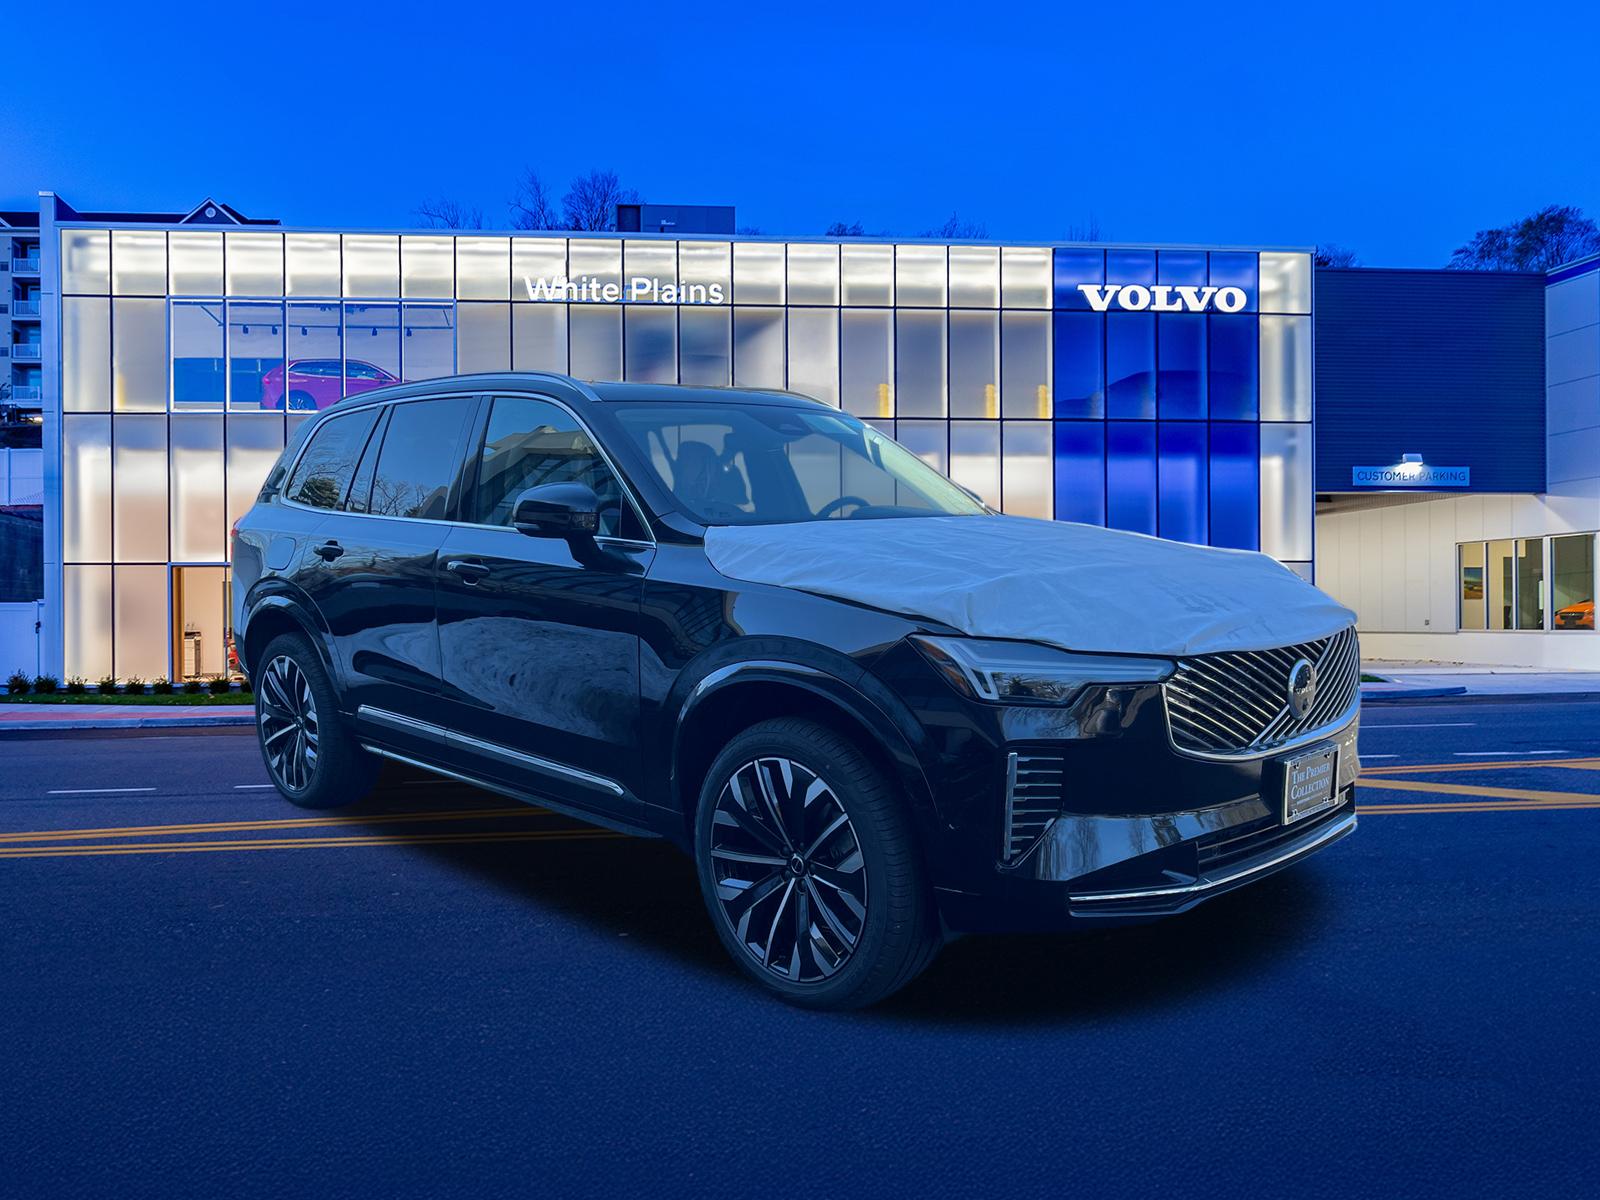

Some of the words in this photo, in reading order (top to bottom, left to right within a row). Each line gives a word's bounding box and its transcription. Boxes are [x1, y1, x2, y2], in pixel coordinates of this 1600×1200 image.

[524, 275, 620, 302] White
[631, 277, 725, 304] Plains
[1077, 284, 1247, 313] VOLVO
[1357, 471, 1416, 481] CUSTOMER
[1419, 471, 1466, 481] PARKING
[1291, 777, 1330, 799] COLLECTION
